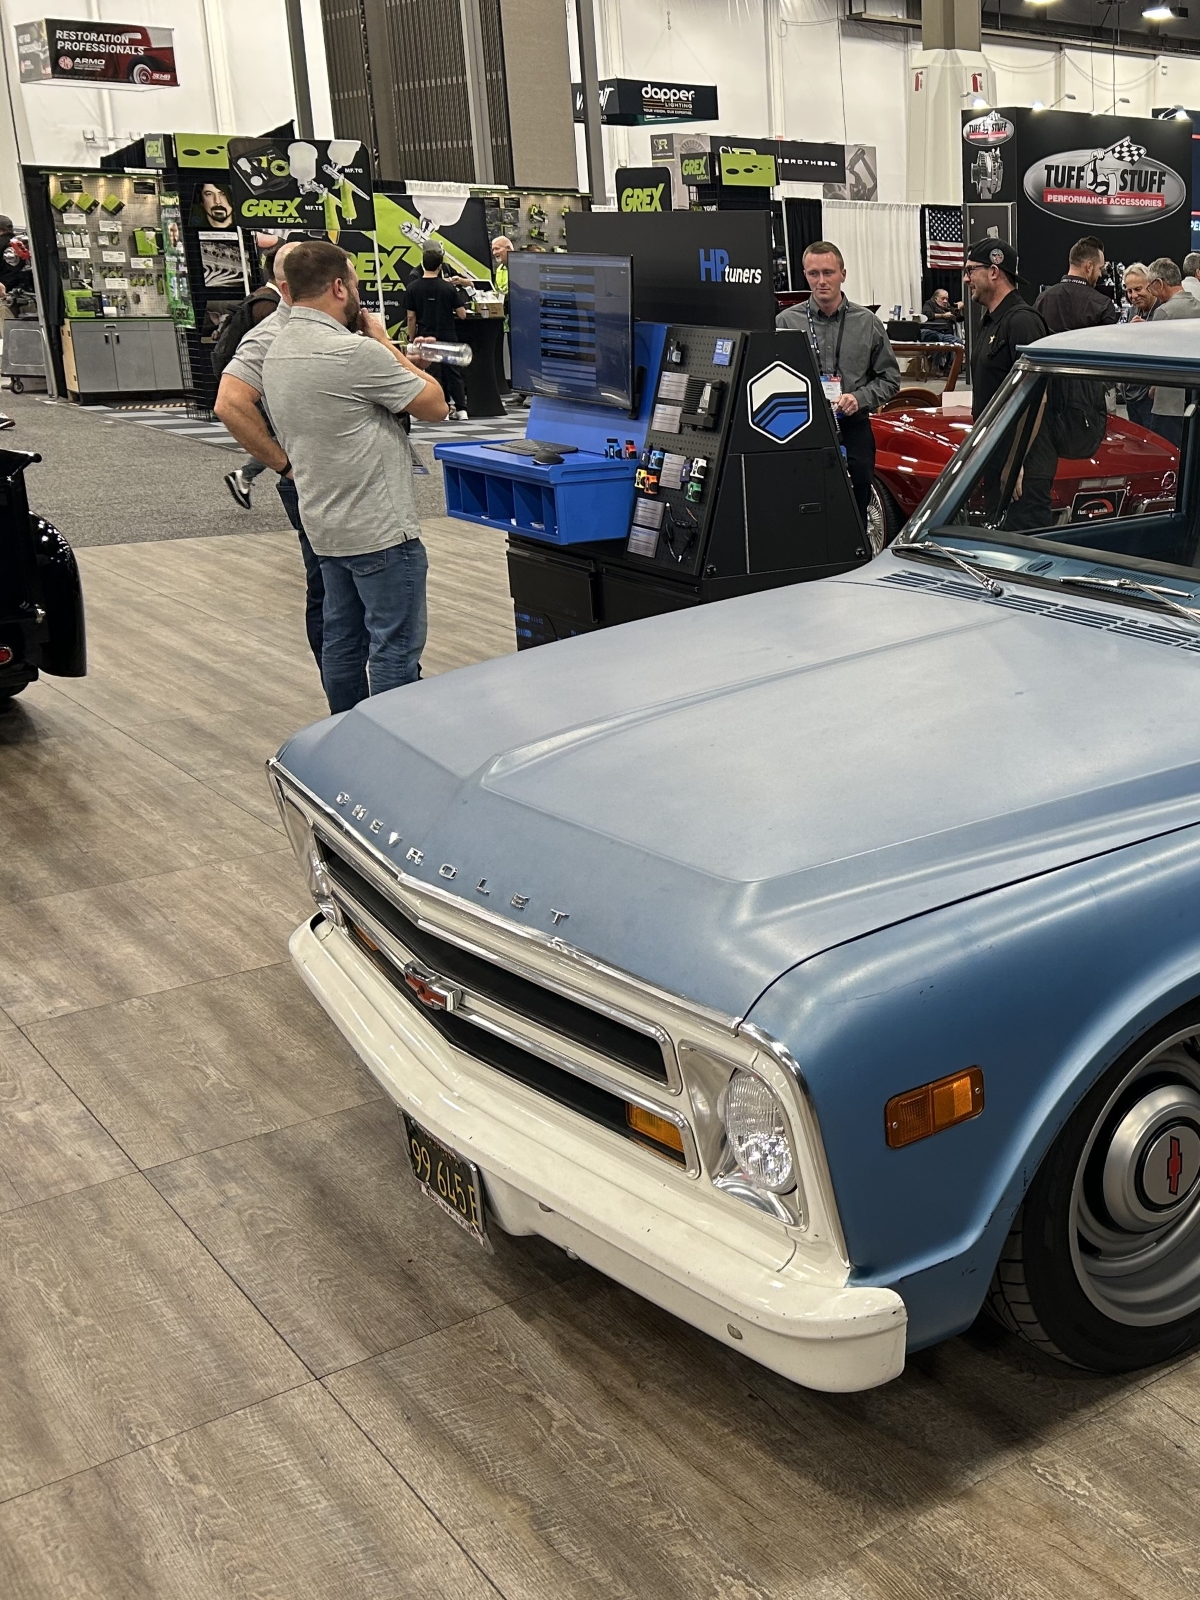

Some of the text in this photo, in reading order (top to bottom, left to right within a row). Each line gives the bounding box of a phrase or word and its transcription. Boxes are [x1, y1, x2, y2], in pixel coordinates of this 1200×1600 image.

[56, 30, 128, 44] RESTORATION
[57, 41, 144, 56] PROFESSIONALS
[642, 84, 694, 102] dapper
[969, 122, 1007, 133] TUFF STUFF
[682, 156, 706, 176] GREX
[1044, 164, 1166, 192] TUFF STUFF
[621, 183, 665, 212] GREX
[1048, 194, 1162, 207] PERFORMANCE ACCESSORIES
[241, 198, 303, 218] GREX
[366, 282, 407, 291] USA
[336, 791, 570, 926] CHEVROLET
[412, 1139, 431, 1182] 99
